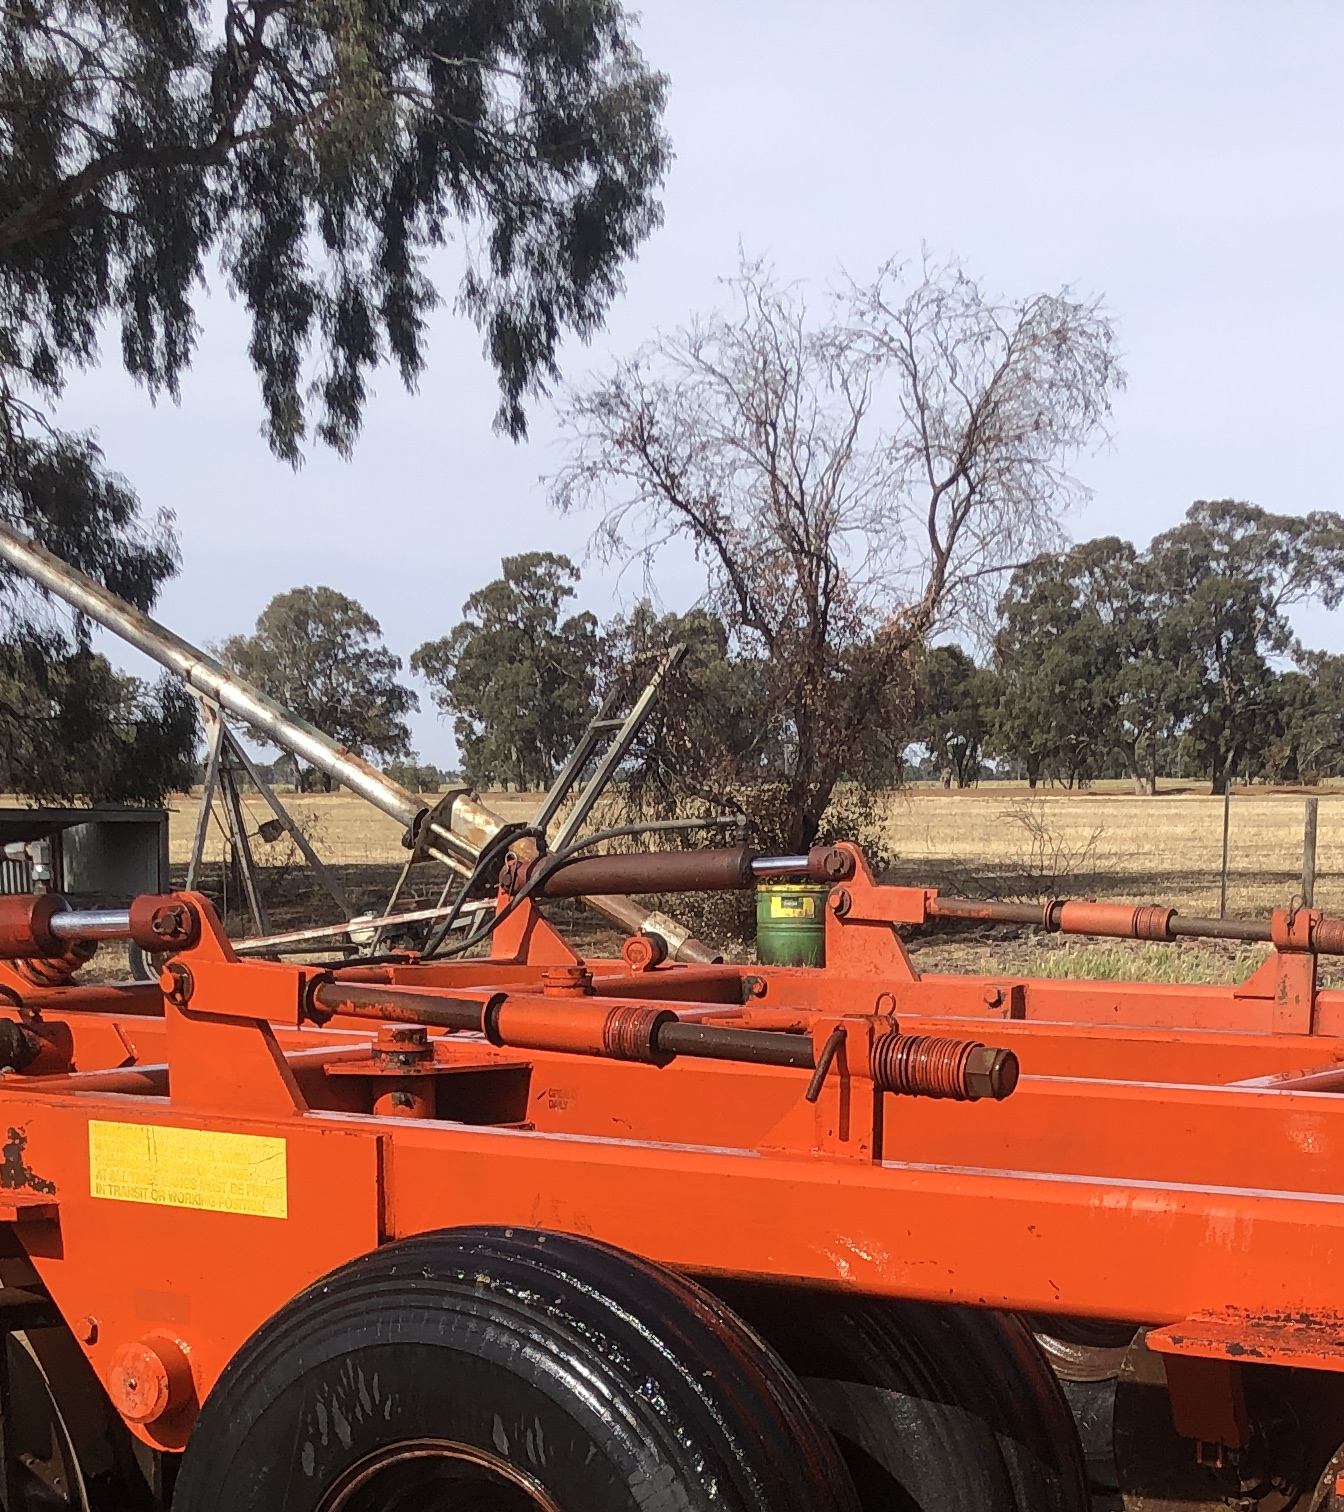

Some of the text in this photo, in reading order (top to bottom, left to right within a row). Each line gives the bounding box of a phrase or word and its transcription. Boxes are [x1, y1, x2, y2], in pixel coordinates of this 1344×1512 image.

[95, 1183, 105, 1194] IN
[108, 1184, 148, 1199] TRANSIT
[150, 1189, 165, 1201] OR
[168, 1191, 215, 1206] WORKING
